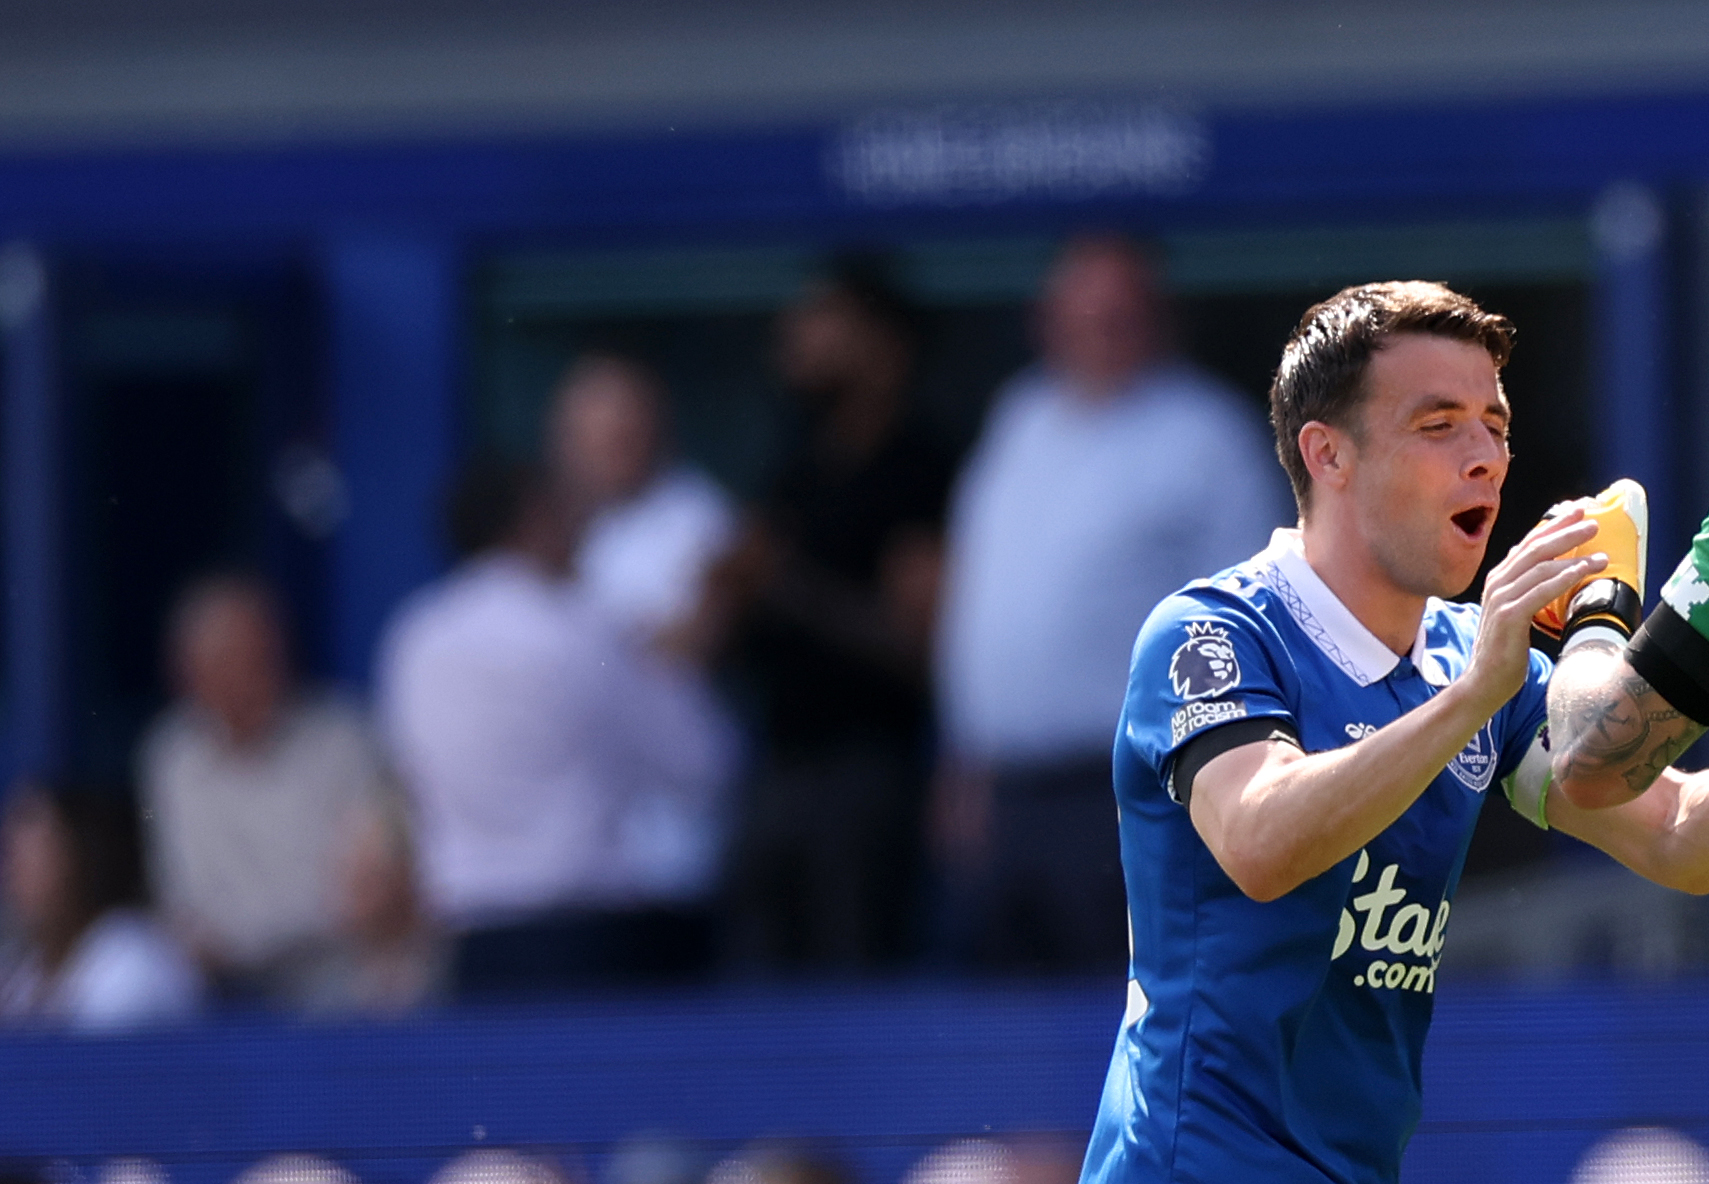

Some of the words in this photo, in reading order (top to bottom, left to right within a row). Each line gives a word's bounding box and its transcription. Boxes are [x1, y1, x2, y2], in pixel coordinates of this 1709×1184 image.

[1171, 710, 1186, 727] No
[1187, 702, 1236, 717] room
[1189, 709, 1247, 731] racism
[1459, 752, 1488, 764] Everton
[1353, 960, 1434, 993] .com
